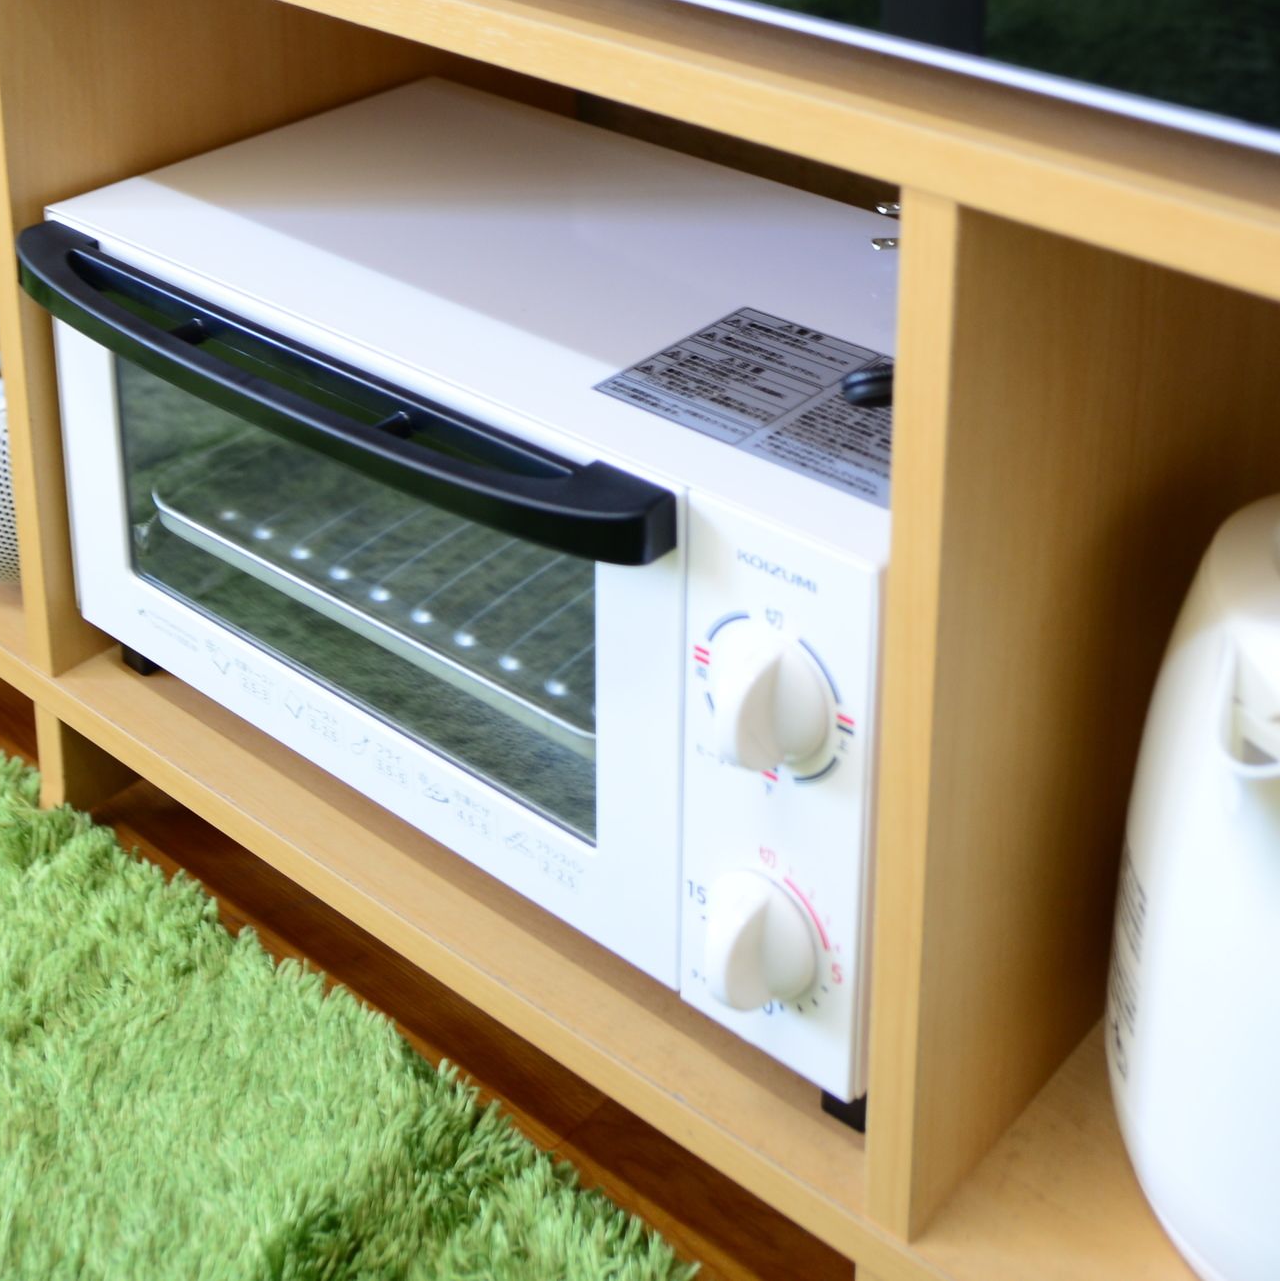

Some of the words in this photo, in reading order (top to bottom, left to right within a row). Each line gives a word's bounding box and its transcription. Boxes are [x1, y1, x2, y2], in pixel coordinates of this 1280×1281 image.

[736, 548, 818, 594] KOIZUMI
[687, 879, 707, 905] 15
[831, 963, 844, 985] 5
